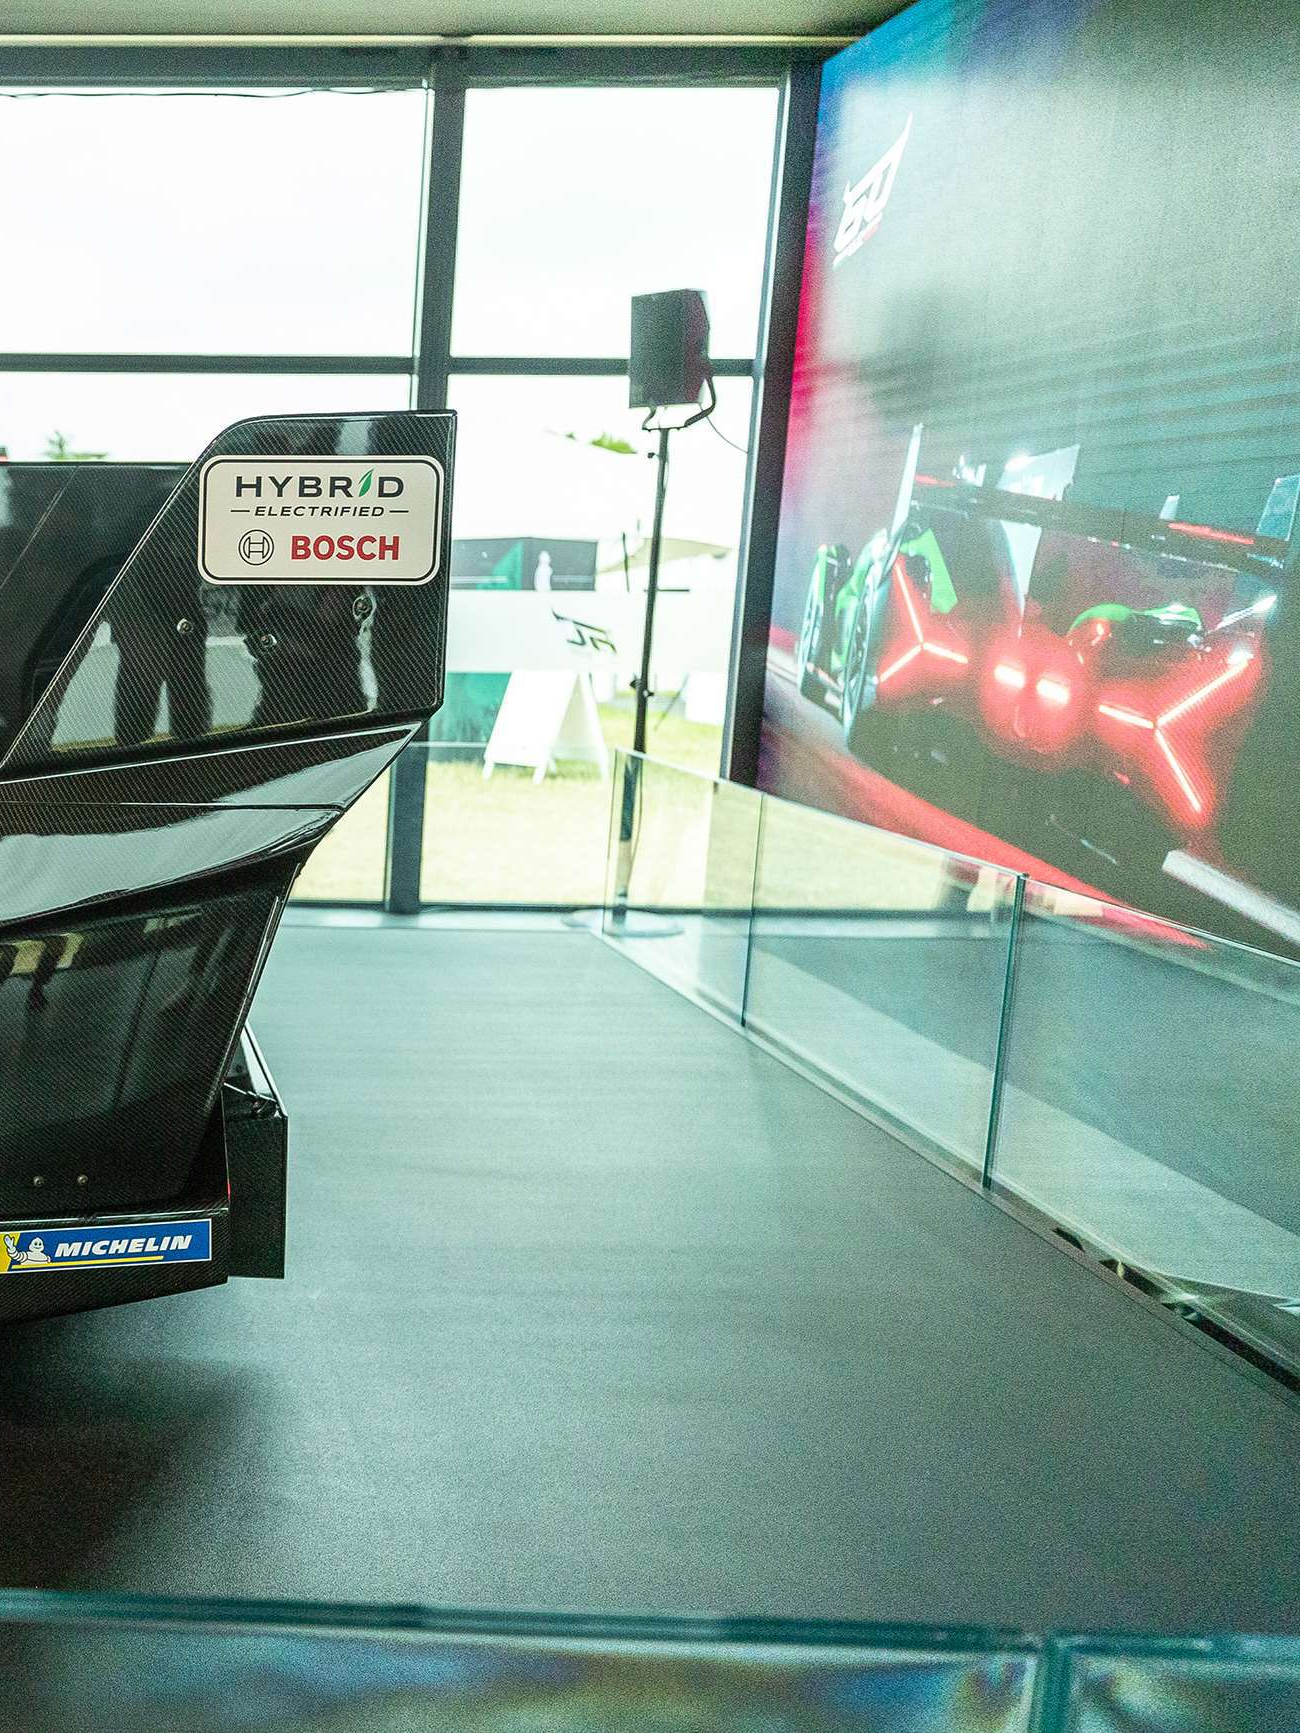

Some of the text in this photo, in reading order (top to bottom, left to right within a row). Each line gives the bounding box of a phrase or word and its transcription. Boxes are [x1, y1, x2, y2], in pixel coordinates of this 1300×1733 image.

[235, 468, 405, 498] HYBRID
[254, 506, 385, 517] ELECTRIFIED
[291, 535, 400, 561] BOSCH
[54, 1235, 193, 1258] MICHELIN
